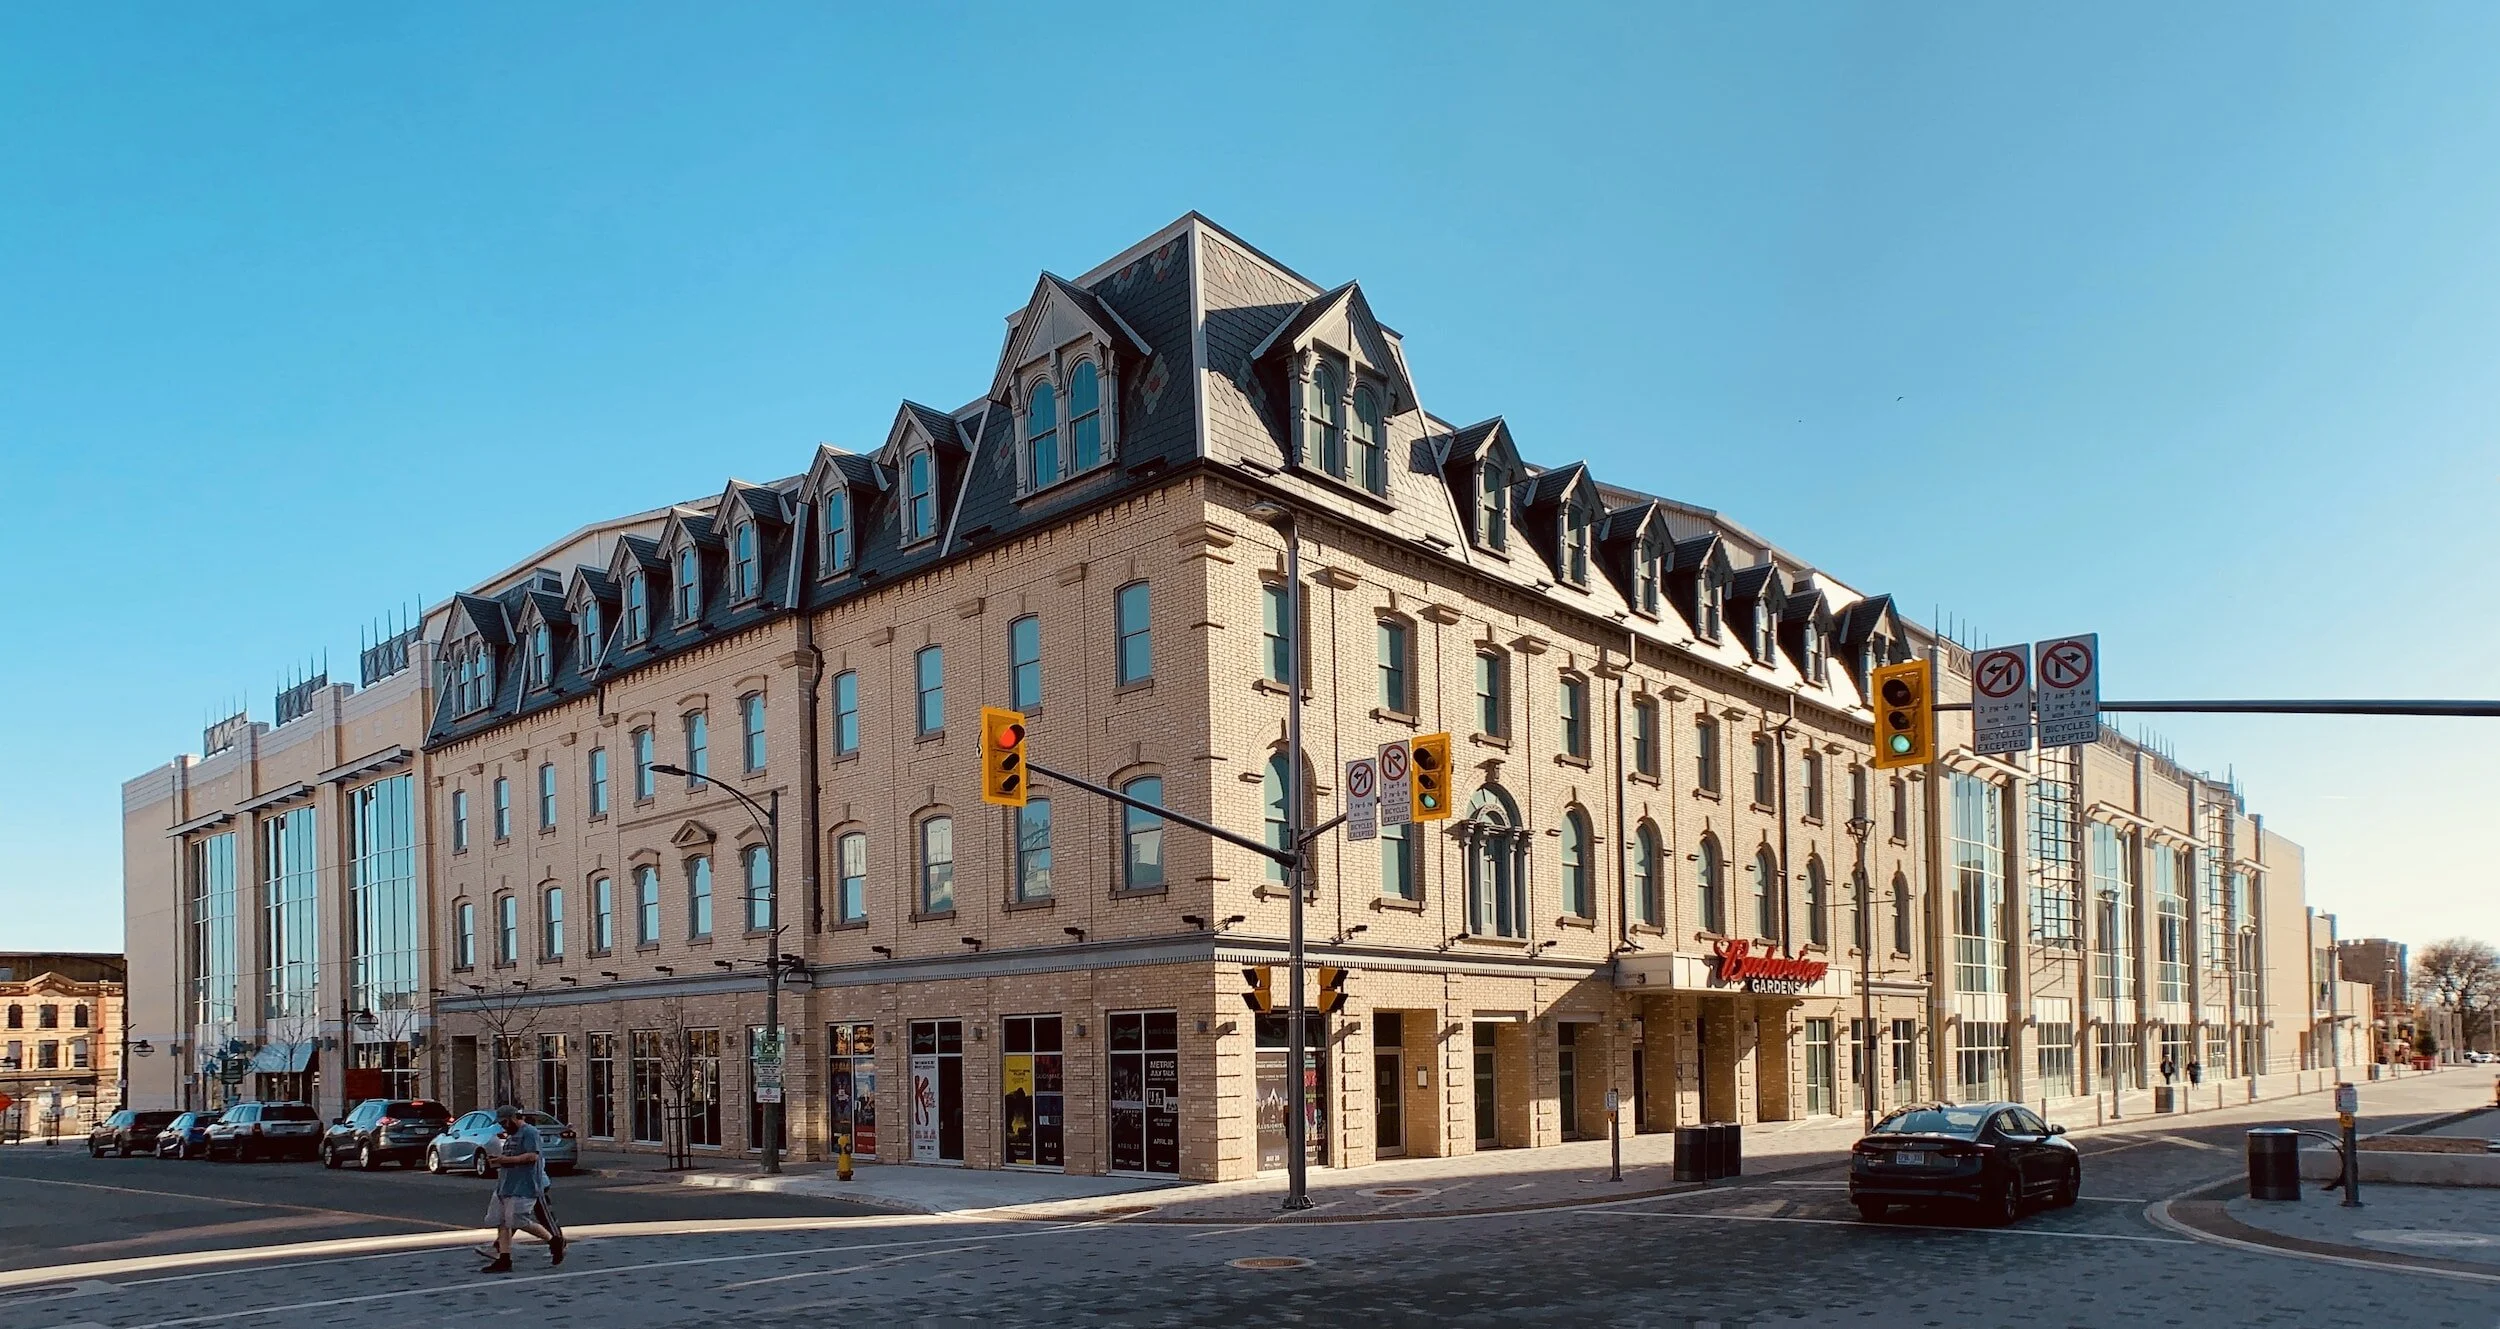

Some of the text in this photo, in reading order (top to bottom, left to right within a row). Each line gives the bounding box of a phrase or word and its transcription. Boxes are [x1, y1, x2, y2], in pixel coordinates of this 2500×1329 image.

[2044, 693, 2050, 701] 7
[1979, 705, 1985, 714] 3
[2044, 703, 2050, 712] 3
[2045, 720, 2091, 734] BICYCLES
[1980, 729, 2023, 742] BICYCLES
[2043, 731, 2094, 744] EXCEPTED
[1977, 740, 2026, 752] EXCEPTED
[1385, 806, 1409, 815] BICYCLES
[1384, 814, 1409, 823] EXCEPTED
[1351, 823, 1373, 831] BICYCLES
[1350, 830, 1374, 839] EXCEPTED
[1712, 938, 1829, 982] Budweiser
[1751, 979, 1801, 995] GARDENS
[227, 1060, 239, 1070] P
[1150, 1060, 1175, 1069] METRIC
